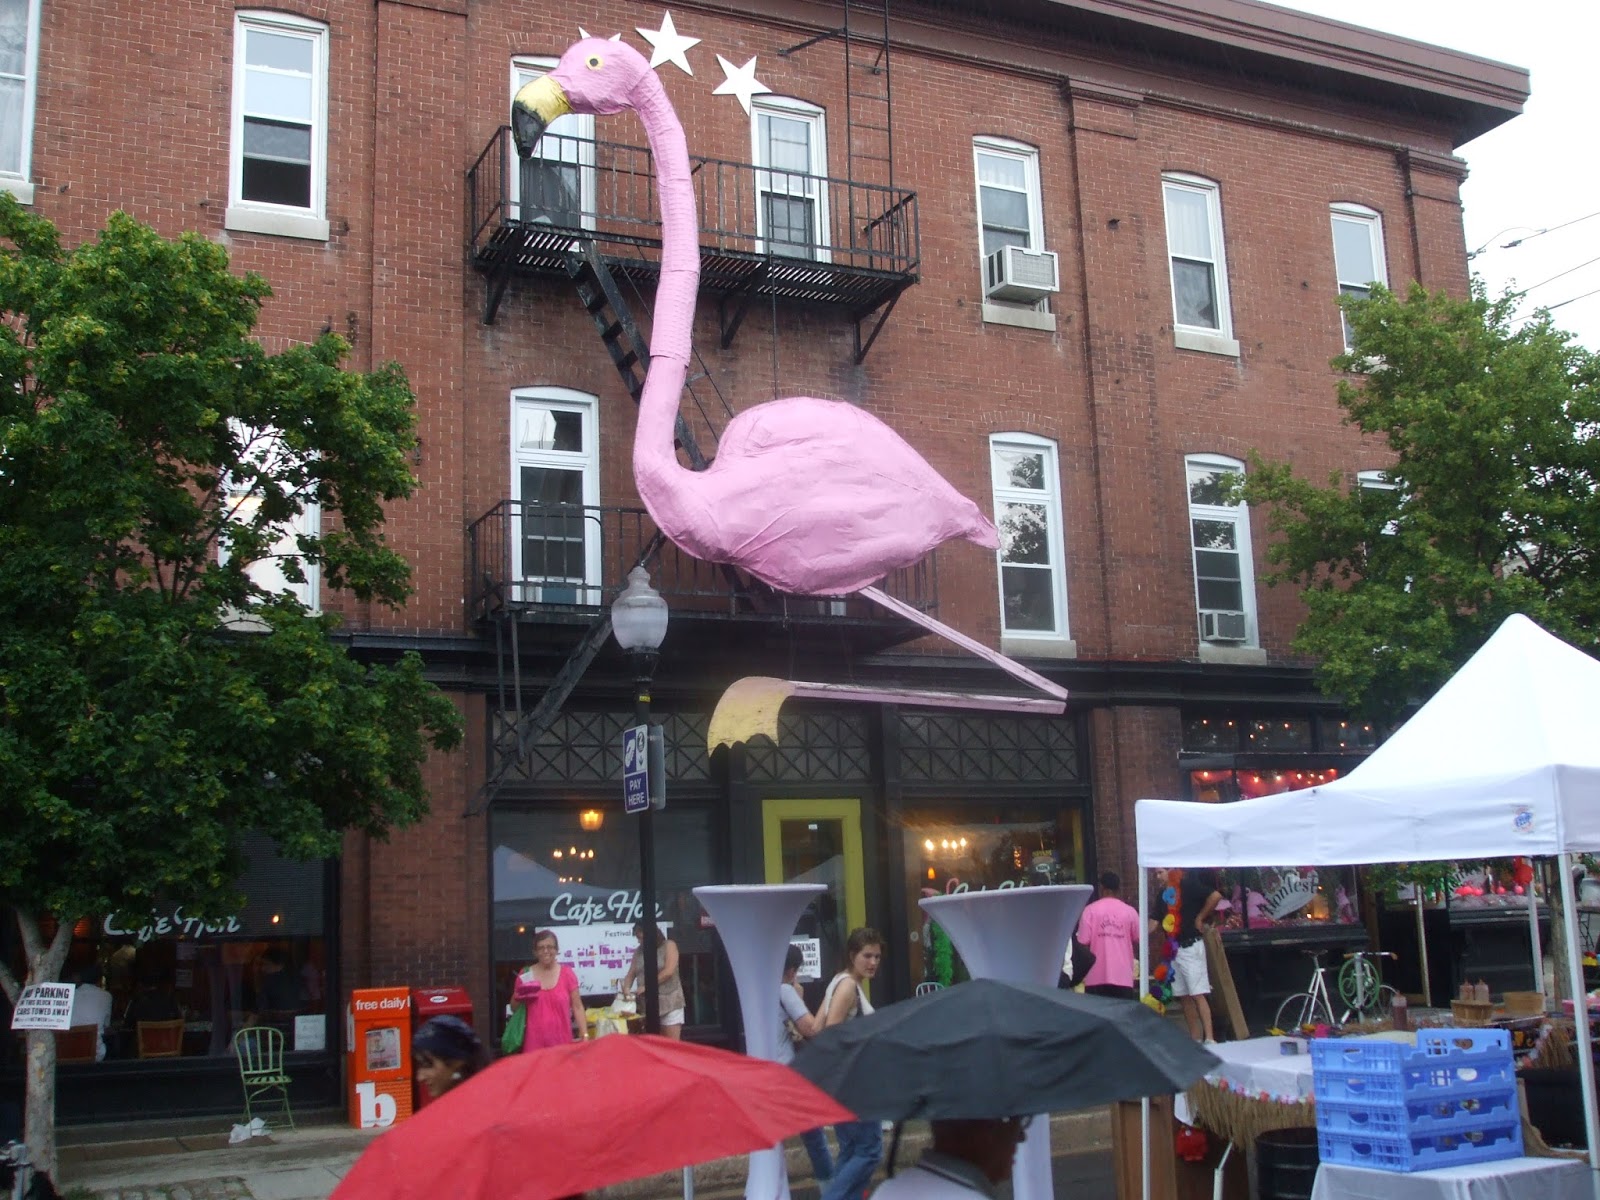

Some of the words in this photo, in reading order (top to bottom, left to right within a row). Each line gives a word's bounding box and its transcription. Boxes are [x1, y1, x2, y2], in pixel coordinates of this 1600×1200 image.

[629, 778, 642, 791] PAY
[628, 792, 645, 806] HERE
[604, 930, 632, 938] Festival
[34, 987, 70, 999] PARKING
[356, 999, 378, 1011] free
[379, 996, 406, 1010] daily
[16, 1008, 31, 1016] CARS
[31, 1008, 51, 1016] TOWED
[52, 1008, 70, 1016] AWAY
[356, 1083, 397, 1129] b
